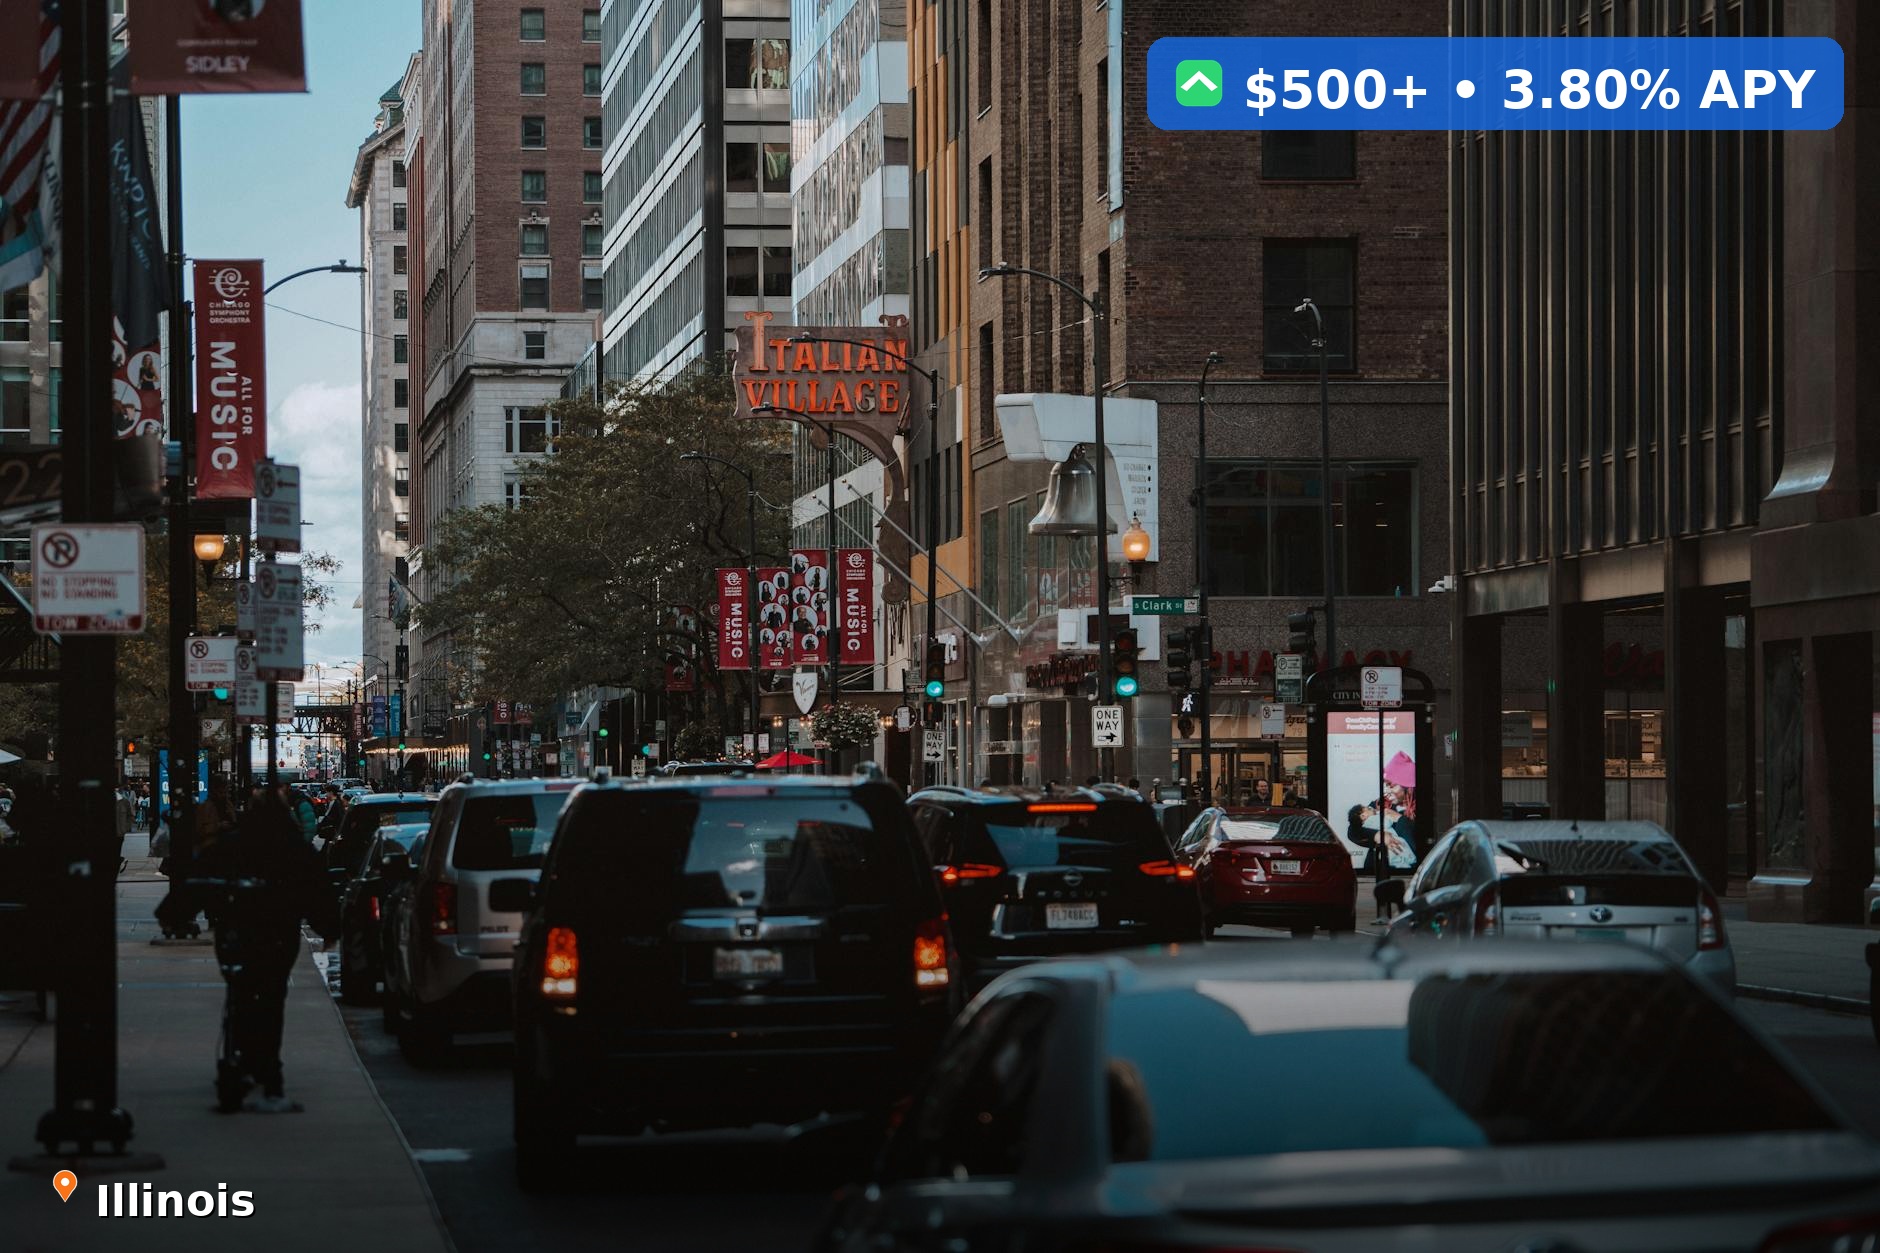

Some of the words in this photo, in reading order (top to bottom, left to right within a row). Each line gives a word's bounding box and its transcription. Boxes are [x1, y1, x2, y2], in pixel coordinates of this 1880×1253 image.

[186, 55, 250, 73] SIDLEY
[744, 311, 908, 372] ITALIAN
[241, 376, 253, 400] ALL
[741, 379, 900, 413] VILLAGE
[210, 342, 238, 470] MUSIC
[242, 407, 254, 435] FOR
[1142, 600, 1173, 611] Clark
[44, 617, 78, 630] TOW
[89, 617, 129, 630] ZONE
[731, 603, 743, 658] MUSIC
[847, 588, 861, 650] MUSIC
[1209, 650, 1413, 676] PHAMACY
[1333, 692, 1354, 700] CITY
[1097, 711, 1118, 719] ONE
[1097, 721, 1119, 730] WAY
[927, 733, 943, 741] ONE
